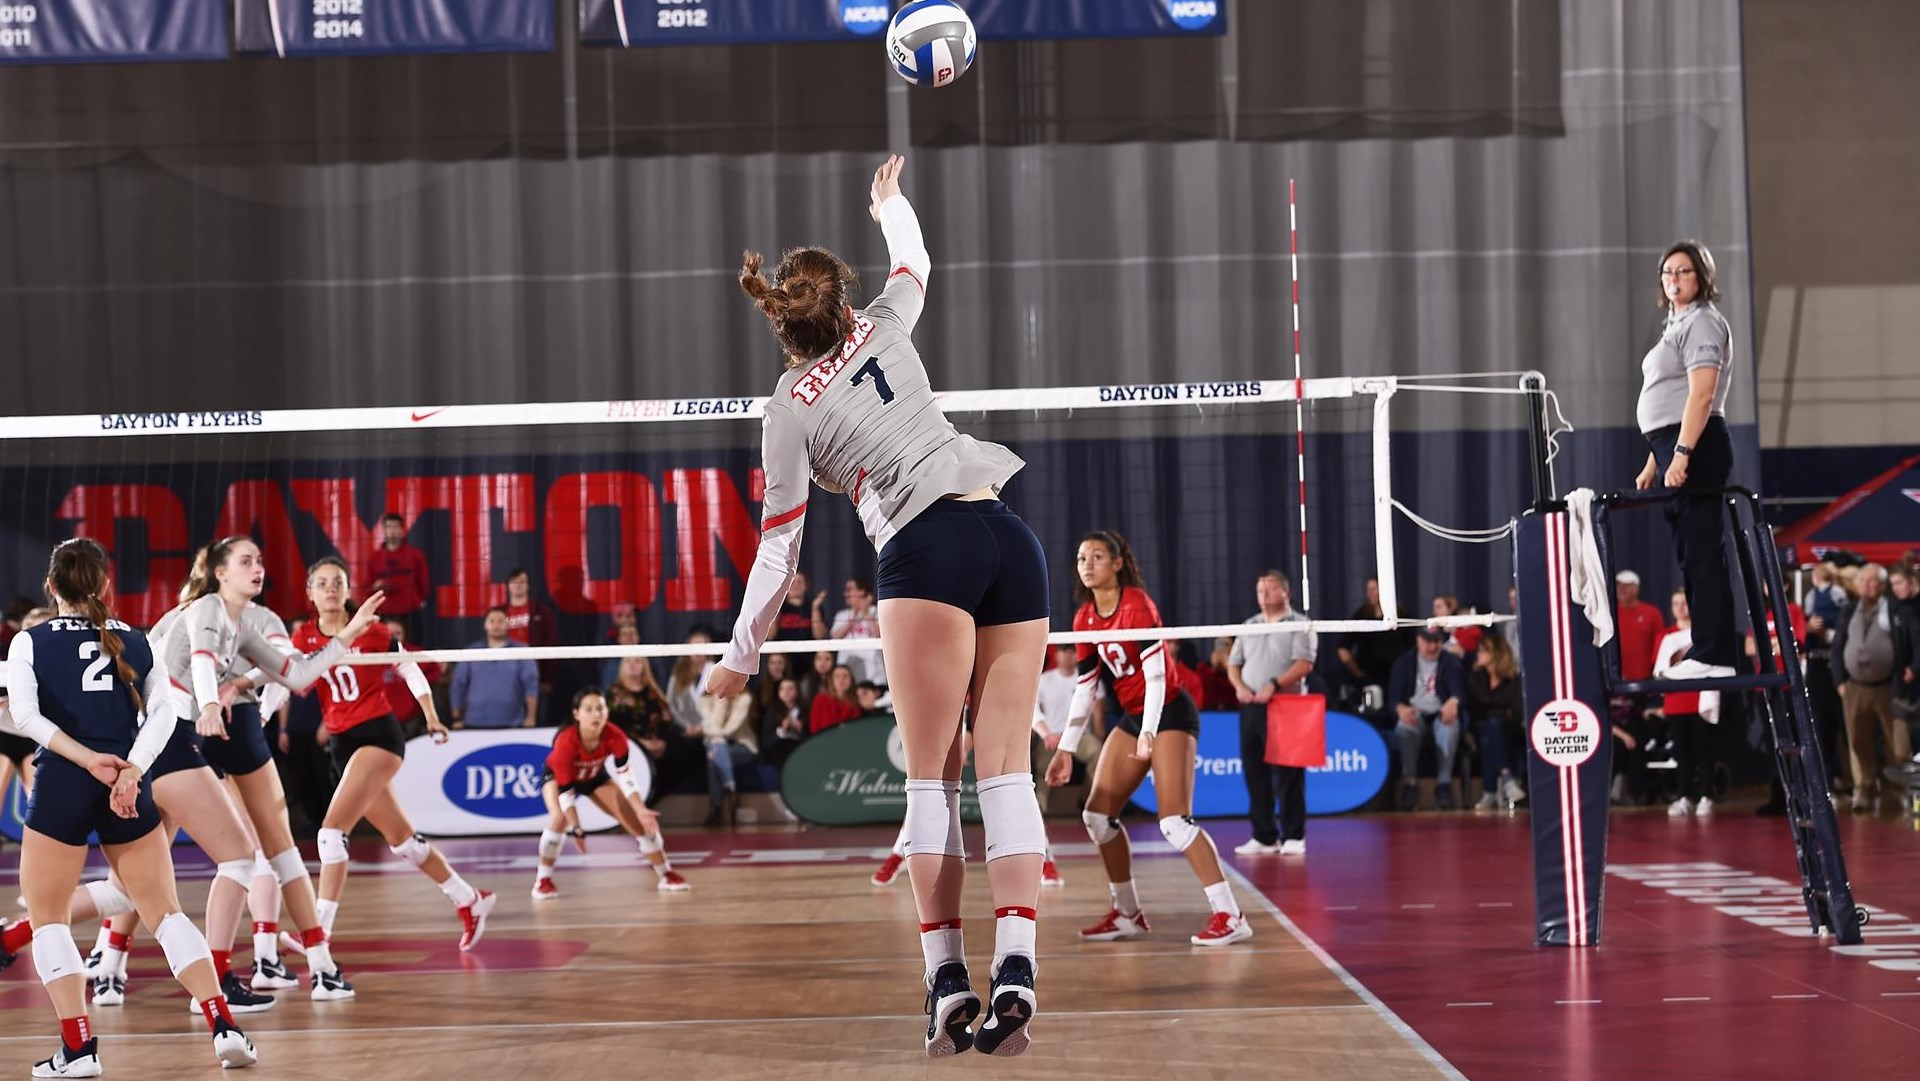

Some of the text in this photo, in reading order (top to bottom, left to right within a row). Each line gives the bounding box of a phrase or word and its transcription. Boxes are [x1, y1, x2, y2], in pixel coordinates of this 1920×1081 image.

[313, 0, 363, 15] 2012
[843, 6, 889, 22] NCAA
[1171, 1, 1217, 17] NCAA
[657, 9, 708, 28] 2012
[313, 20, 364, 38] 2014
[848, 354, 897, 407] 7
[1100, 382, 1262, 401] DAYTON FLYERS
[606, 399, 753, 417] FLYER LEGACY
[101, 409, 263, 430] DAYTON FLYERS
[54, 467, 766, 632] DAYTON
[79, 641, 113, 691] 2
[1096, 641, 1135, 678] 12
[320, 664, 360, 703] 10
[1544, 735, 1589, 745] DAYTON
[1546, 745, 1589, 754] FLYERS
[466, 763, 543, 801] DP&
